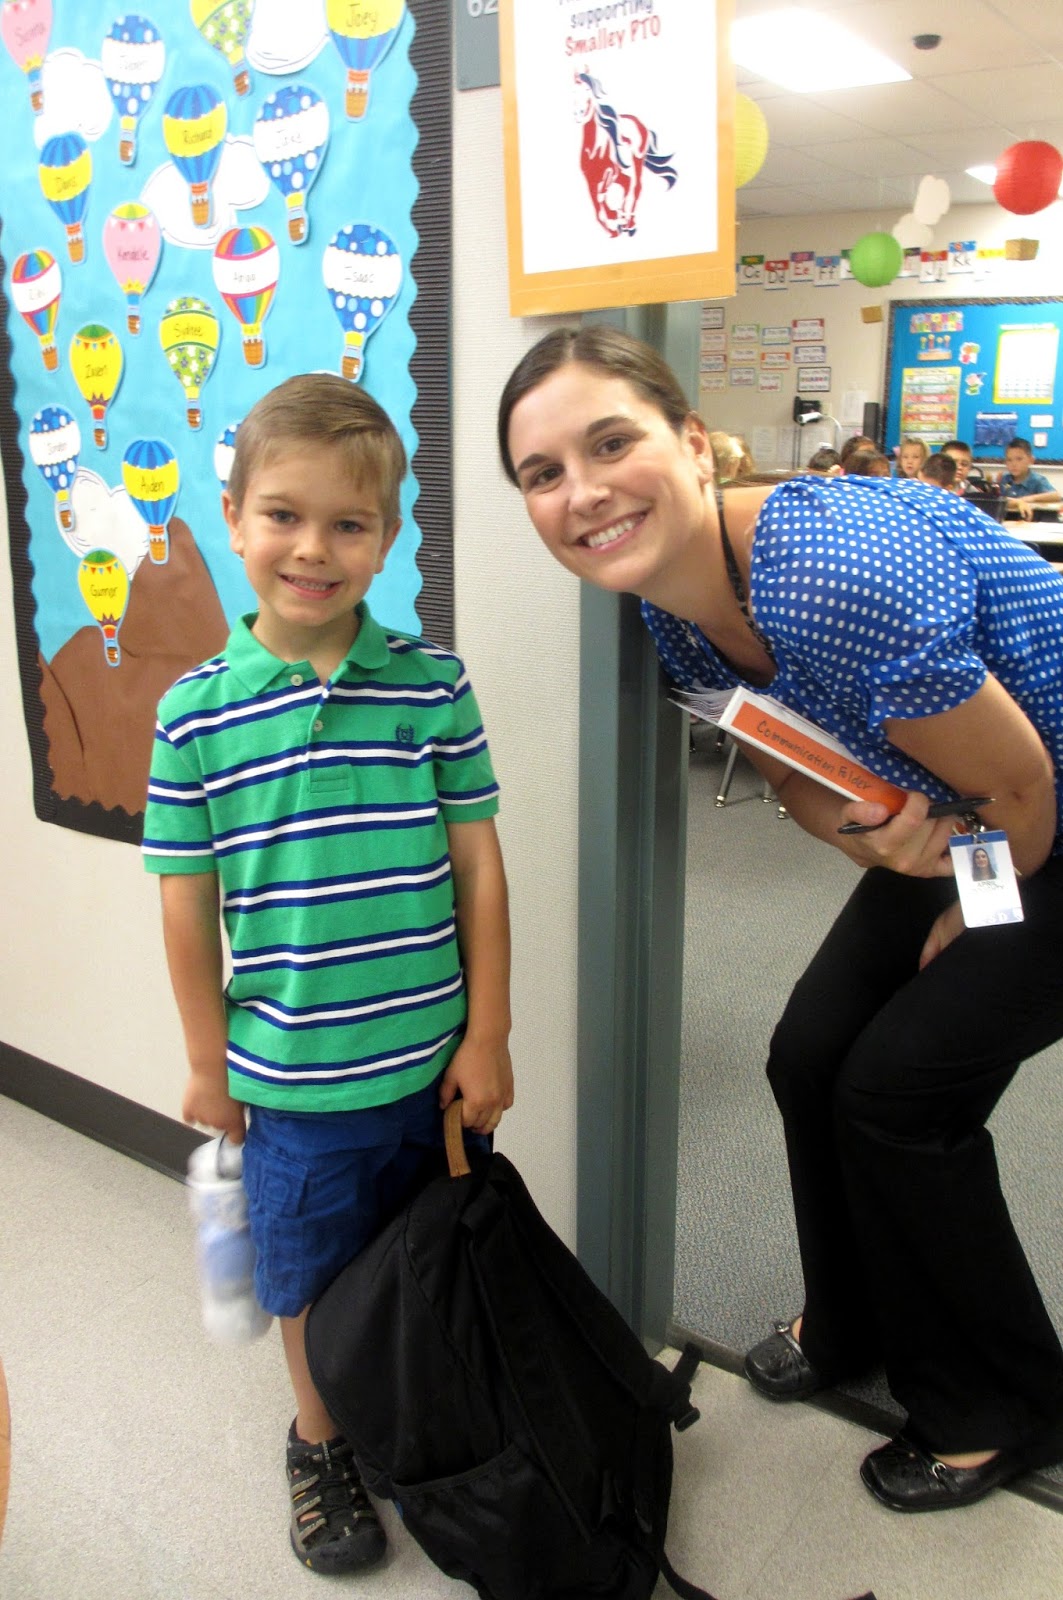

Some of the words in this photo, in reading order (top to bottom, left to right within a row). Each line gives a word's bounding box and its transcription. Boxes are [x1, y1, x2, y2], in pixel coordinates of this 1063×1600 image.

[346, 3, 378, 32] Joey
[570, 0, 654, 29] supporting
[565, 27, 626, 57] Smalley
[630, 15, 661, 42] PTO
[344, 265, 376, 284] Isaac
[756, 720, 835, 773] Communication
[838, 765, 873, 790] Folder
